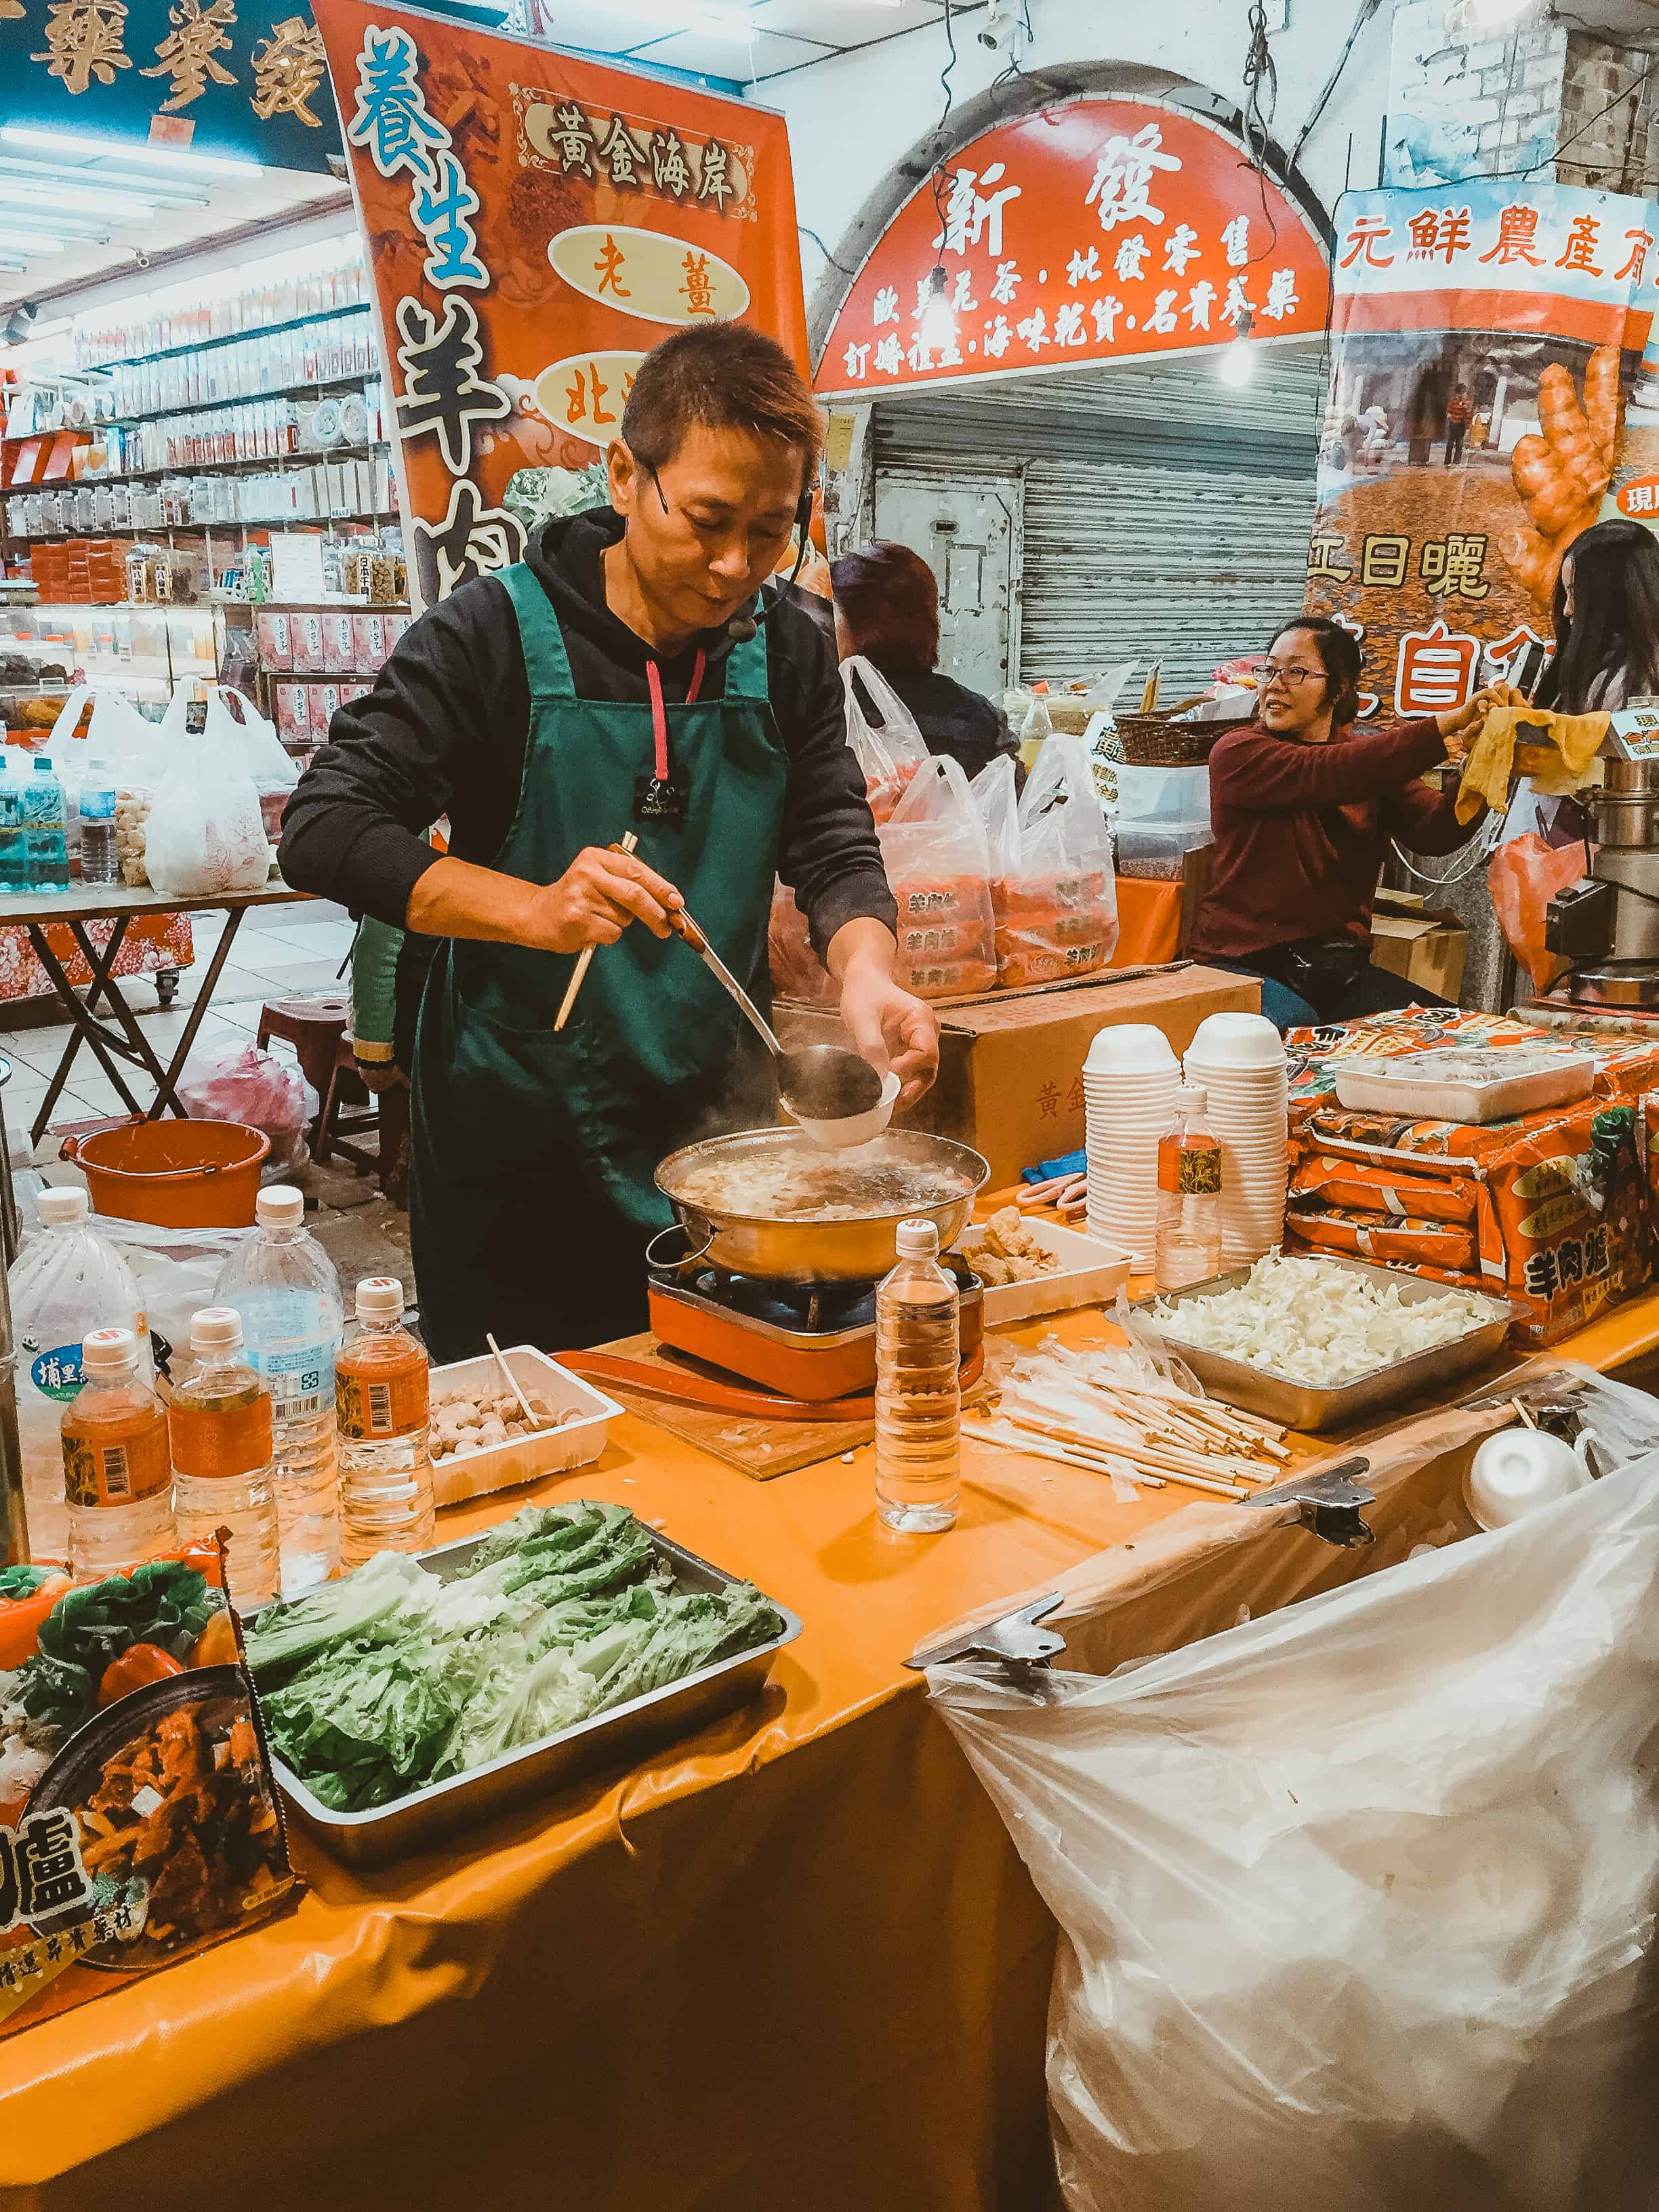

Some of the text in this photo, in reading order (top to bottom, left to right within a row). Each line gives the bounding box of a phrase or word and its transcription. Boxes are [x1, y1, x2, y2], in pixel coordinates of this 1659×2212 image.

[549, 105, 734, 209] 黃金海岸
[565, 362, 636, 424] 北
[1626, 485, 1659, 513] 現
[37, 1357, 88, 1390] 埔里
